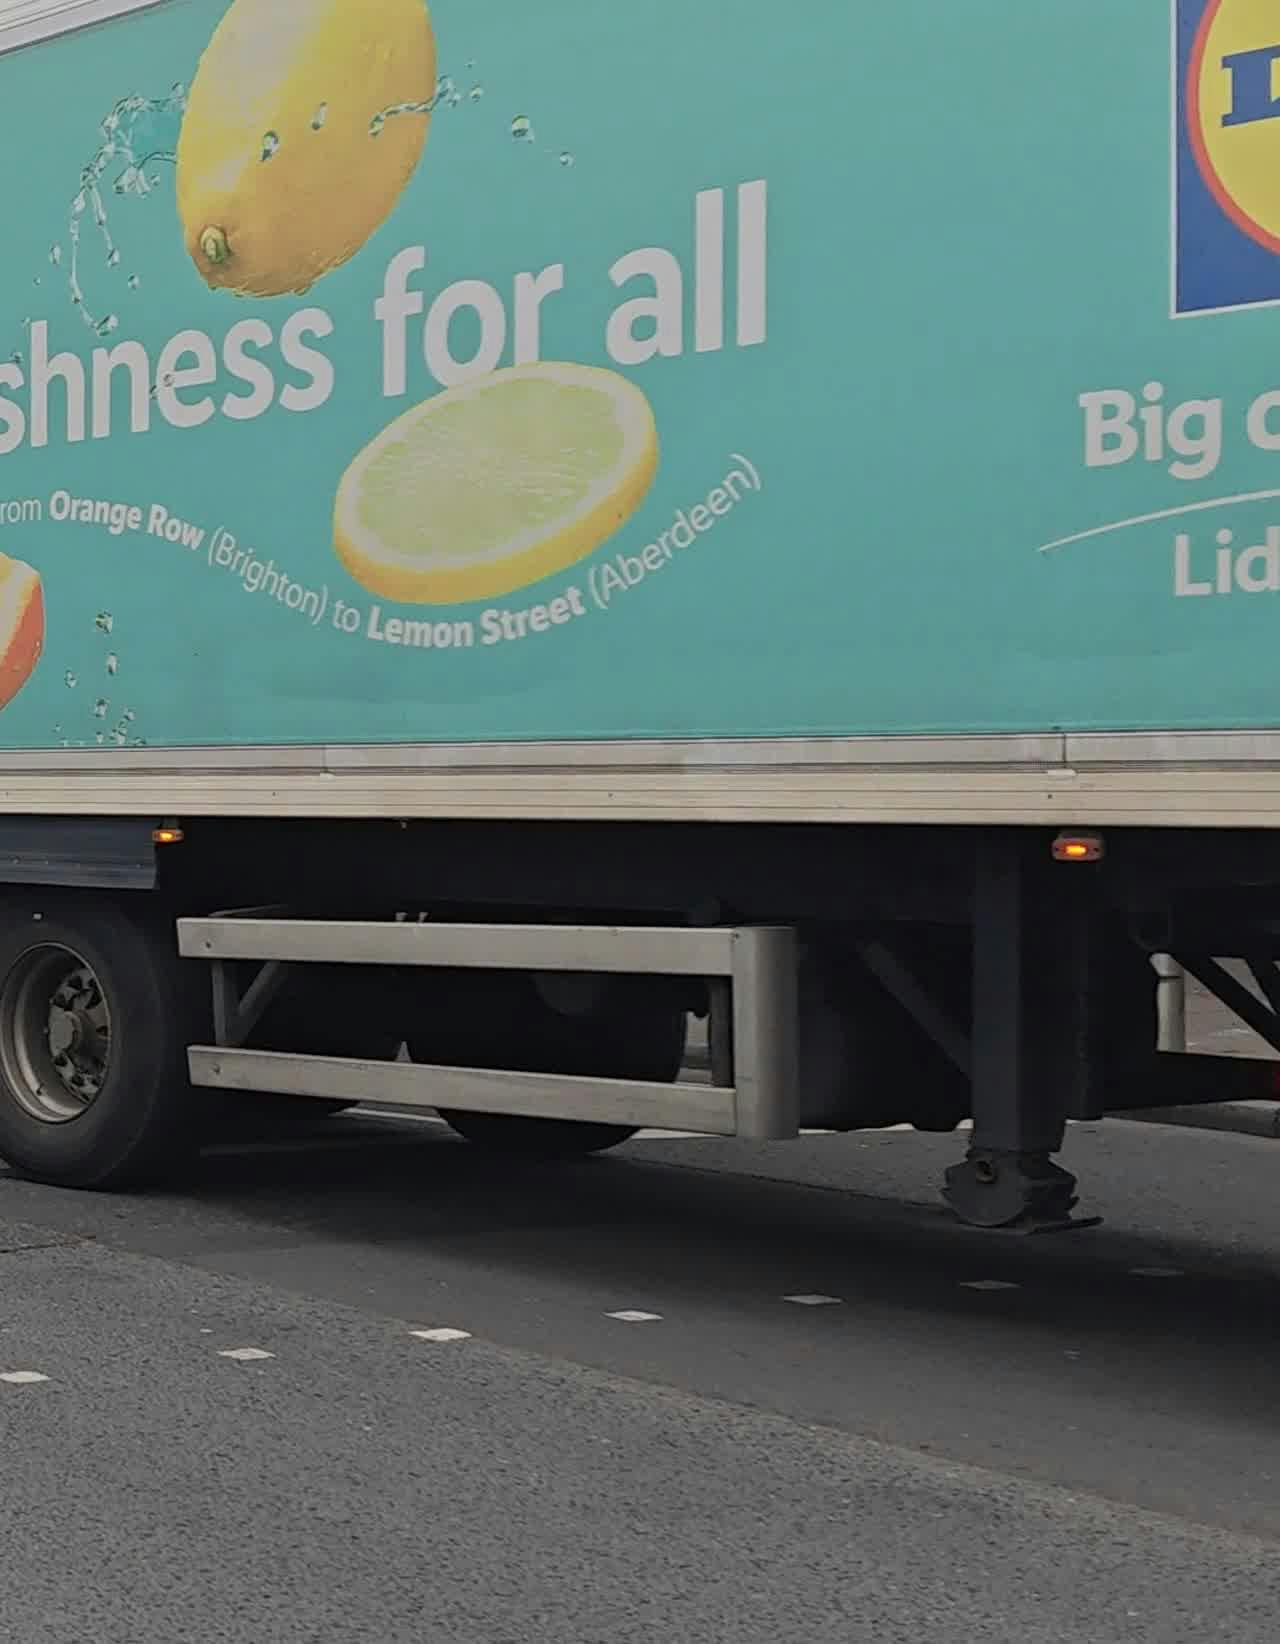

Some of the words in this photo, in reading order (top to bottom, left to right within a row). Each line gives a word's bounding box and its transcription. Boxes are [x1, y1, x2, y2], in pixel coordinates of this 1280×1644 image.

[373, 246, 564, 396] for
[605, 178, 767, 366] all
[1077, 380, 1222, 481] Big
[48, 490, 142, 534] Orange
[146, 503, 205, 551] Row
[208, 525, 329, 626] (Brighton)
[332, 601, 361, 633] to
[366, 604, 474, 650] Lemon
[480, 587, 587, 645] Street
[588, 453, 762, 611] (Aberdeen)
[1173, 526, 1280, 596] Lid
